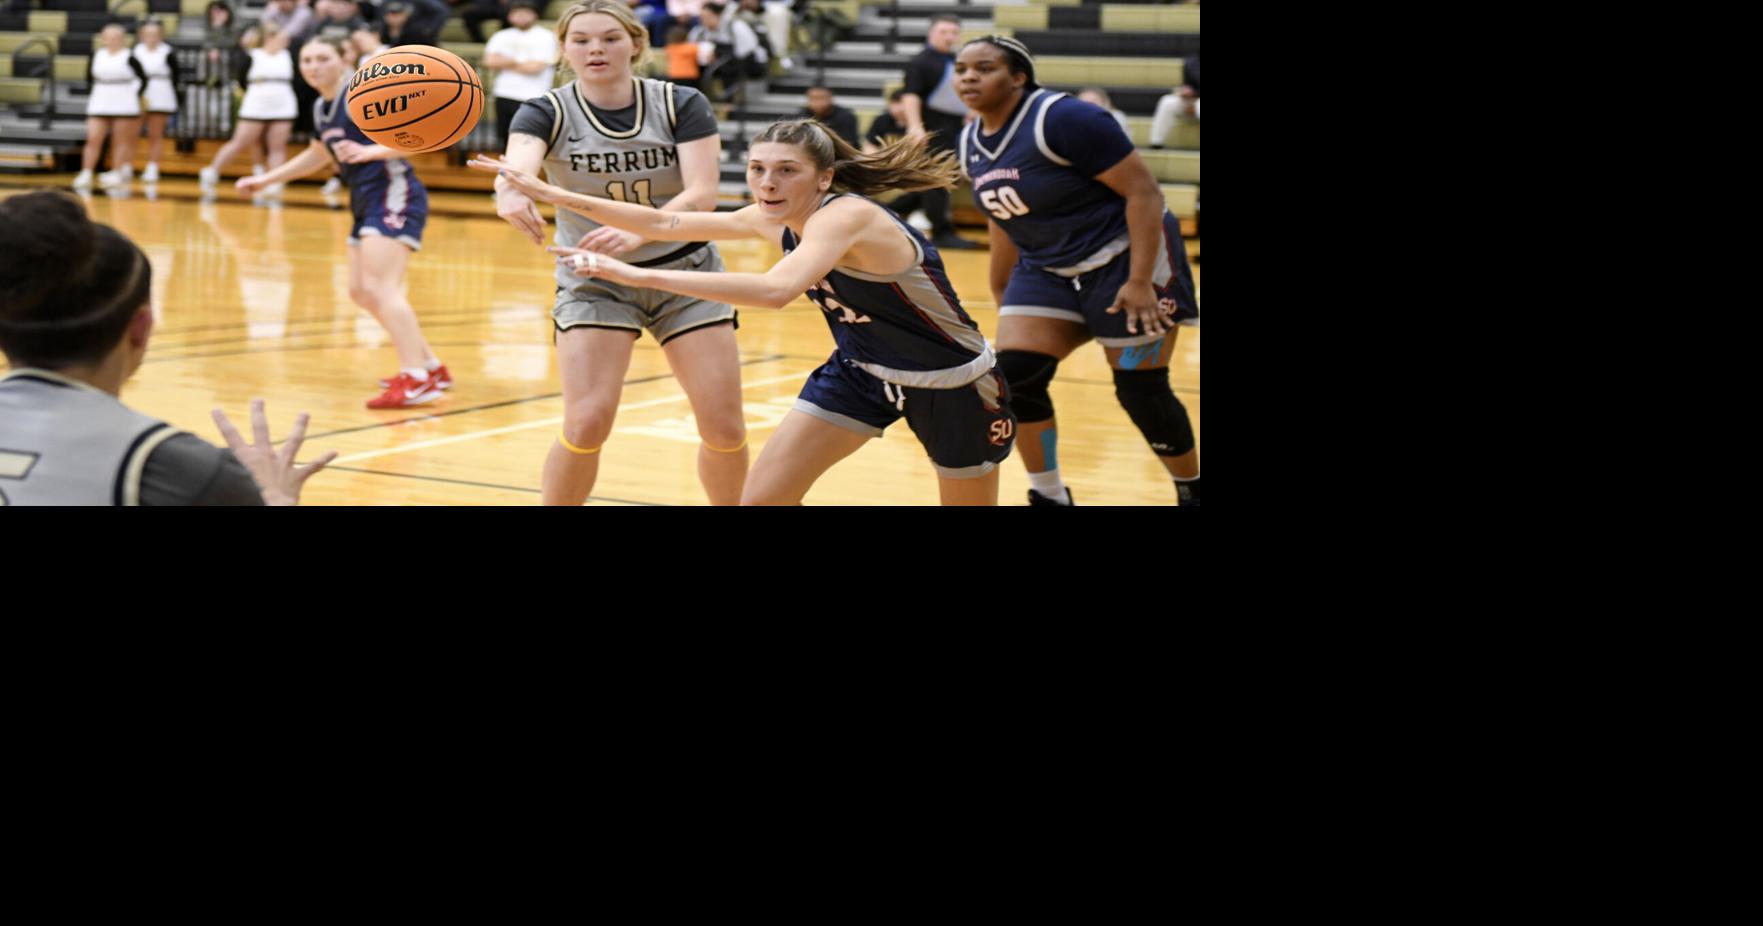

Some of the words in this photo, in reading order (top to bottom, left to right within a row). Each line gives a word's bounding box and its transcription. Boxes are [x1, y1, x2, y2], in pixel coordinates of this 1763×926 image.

[349, 62, 426, 92] Wilson
[408, 90, 427, 101] NXT
[569, 145, 680, 174] FERRUM
[605, 178, 657, 209] 11
[979, 185, 1030, 220] 50
[989, 416, 1013, 442] SU
